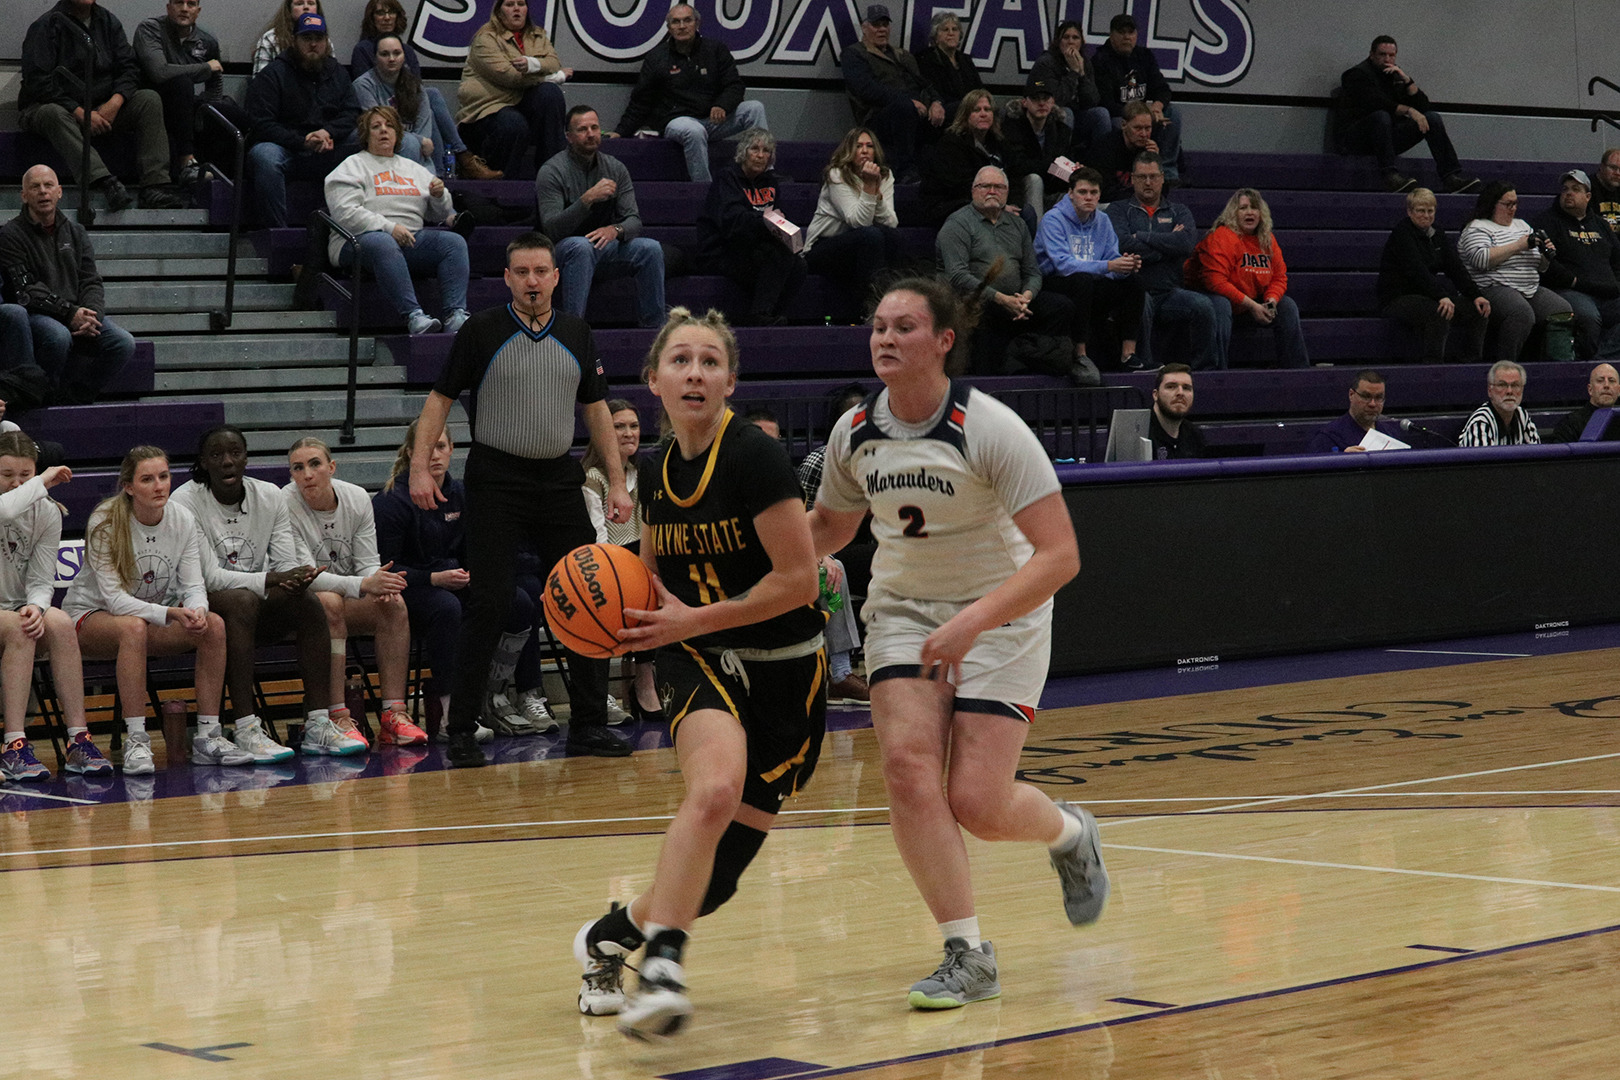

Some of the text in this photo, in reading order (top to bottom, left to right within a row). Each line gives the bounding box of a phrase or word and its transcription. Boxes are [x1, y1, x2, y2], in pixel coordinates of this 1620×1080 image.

[409, 0, 864, 66] SOUX
[866, 467, 955, 497] Marauders
[693, 517, 747, 555] STATE
[897, 504, 929, 539] 2
[548, 570, 577, 621] NCAA
[573, 546, 608, 611] Wilson
[688, 562, 729, 606] 11
[1534, 620, 1569, 629] DAKTRONICS
[1177, 655, 1219, 665] DAKTRONICS
